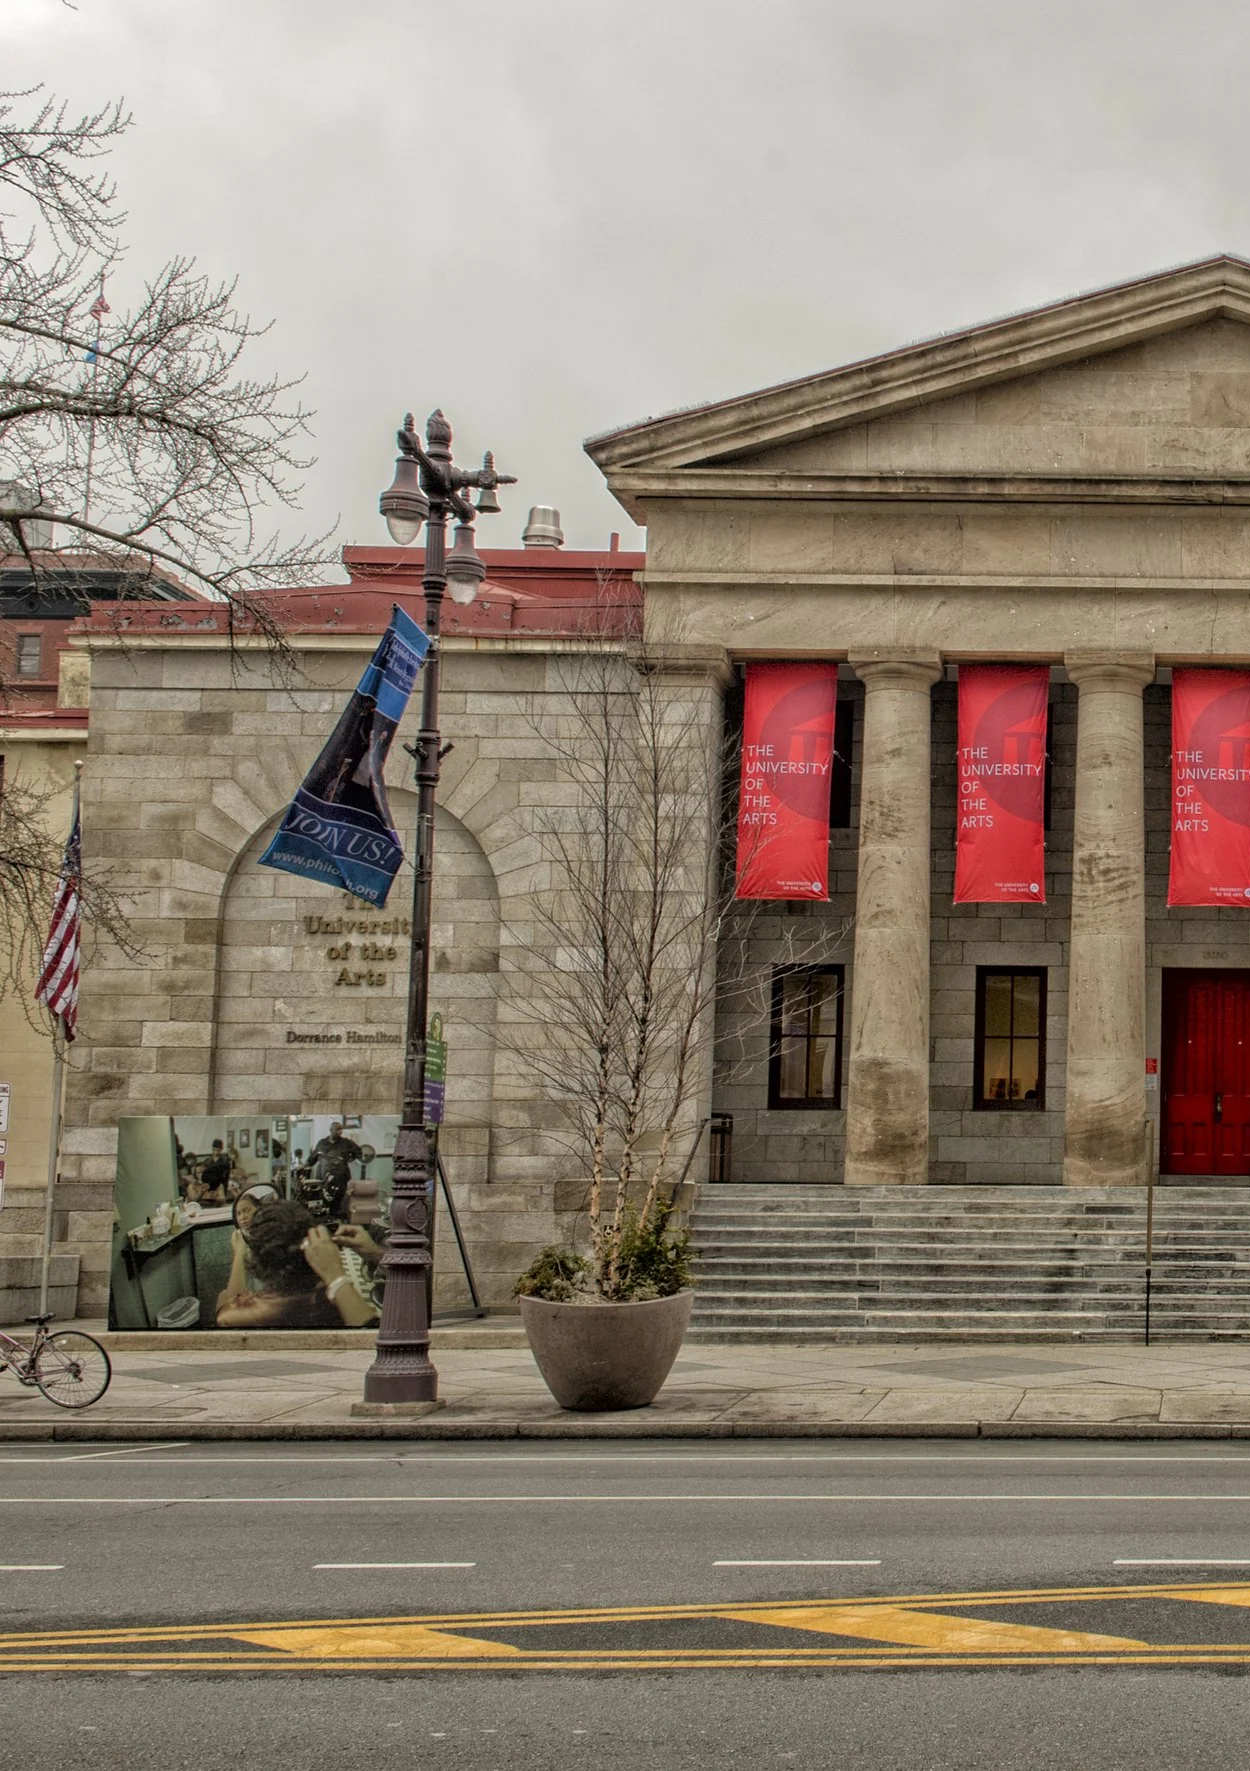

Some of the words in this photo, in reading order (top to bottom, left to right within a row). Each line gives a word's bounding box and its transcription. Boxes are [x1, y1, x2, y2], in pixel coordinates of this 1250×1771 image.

[747, 744, 774, 757] THE
[961, 747, 989, 759] THE
[1176, 750, 1203, 762] THE
[746, 761, 828, 775] UNIVERSITY
[961, 763, 1041, 777] UNIVERSITY
[745, 778, 765, 790] OF
[961, 781, 980, 794] OF
[1176, 785, 1195, 798] OF
[743, 795, 771, 807] THE
[961, 798, 987, 811] THE
[1175, 802, 1202, 815] THE
[742, 813, 777, 825] ARTS
[960, 815, 993, 828] ARTS
[1175, 819, 1209, 832] ARTS
[285, 811, 347, 850] JOIN
[347, 833, 395, 865] US!
[304, 916, 411, 935] Universit
[327, 942, 352, 960] of
[360, 942, 397, 960] the
[335, 967, 387, 986] Arts
[286, 1031, 342, 1043] Dorrance
[346, 1031, 402, 1043] Hamilton
